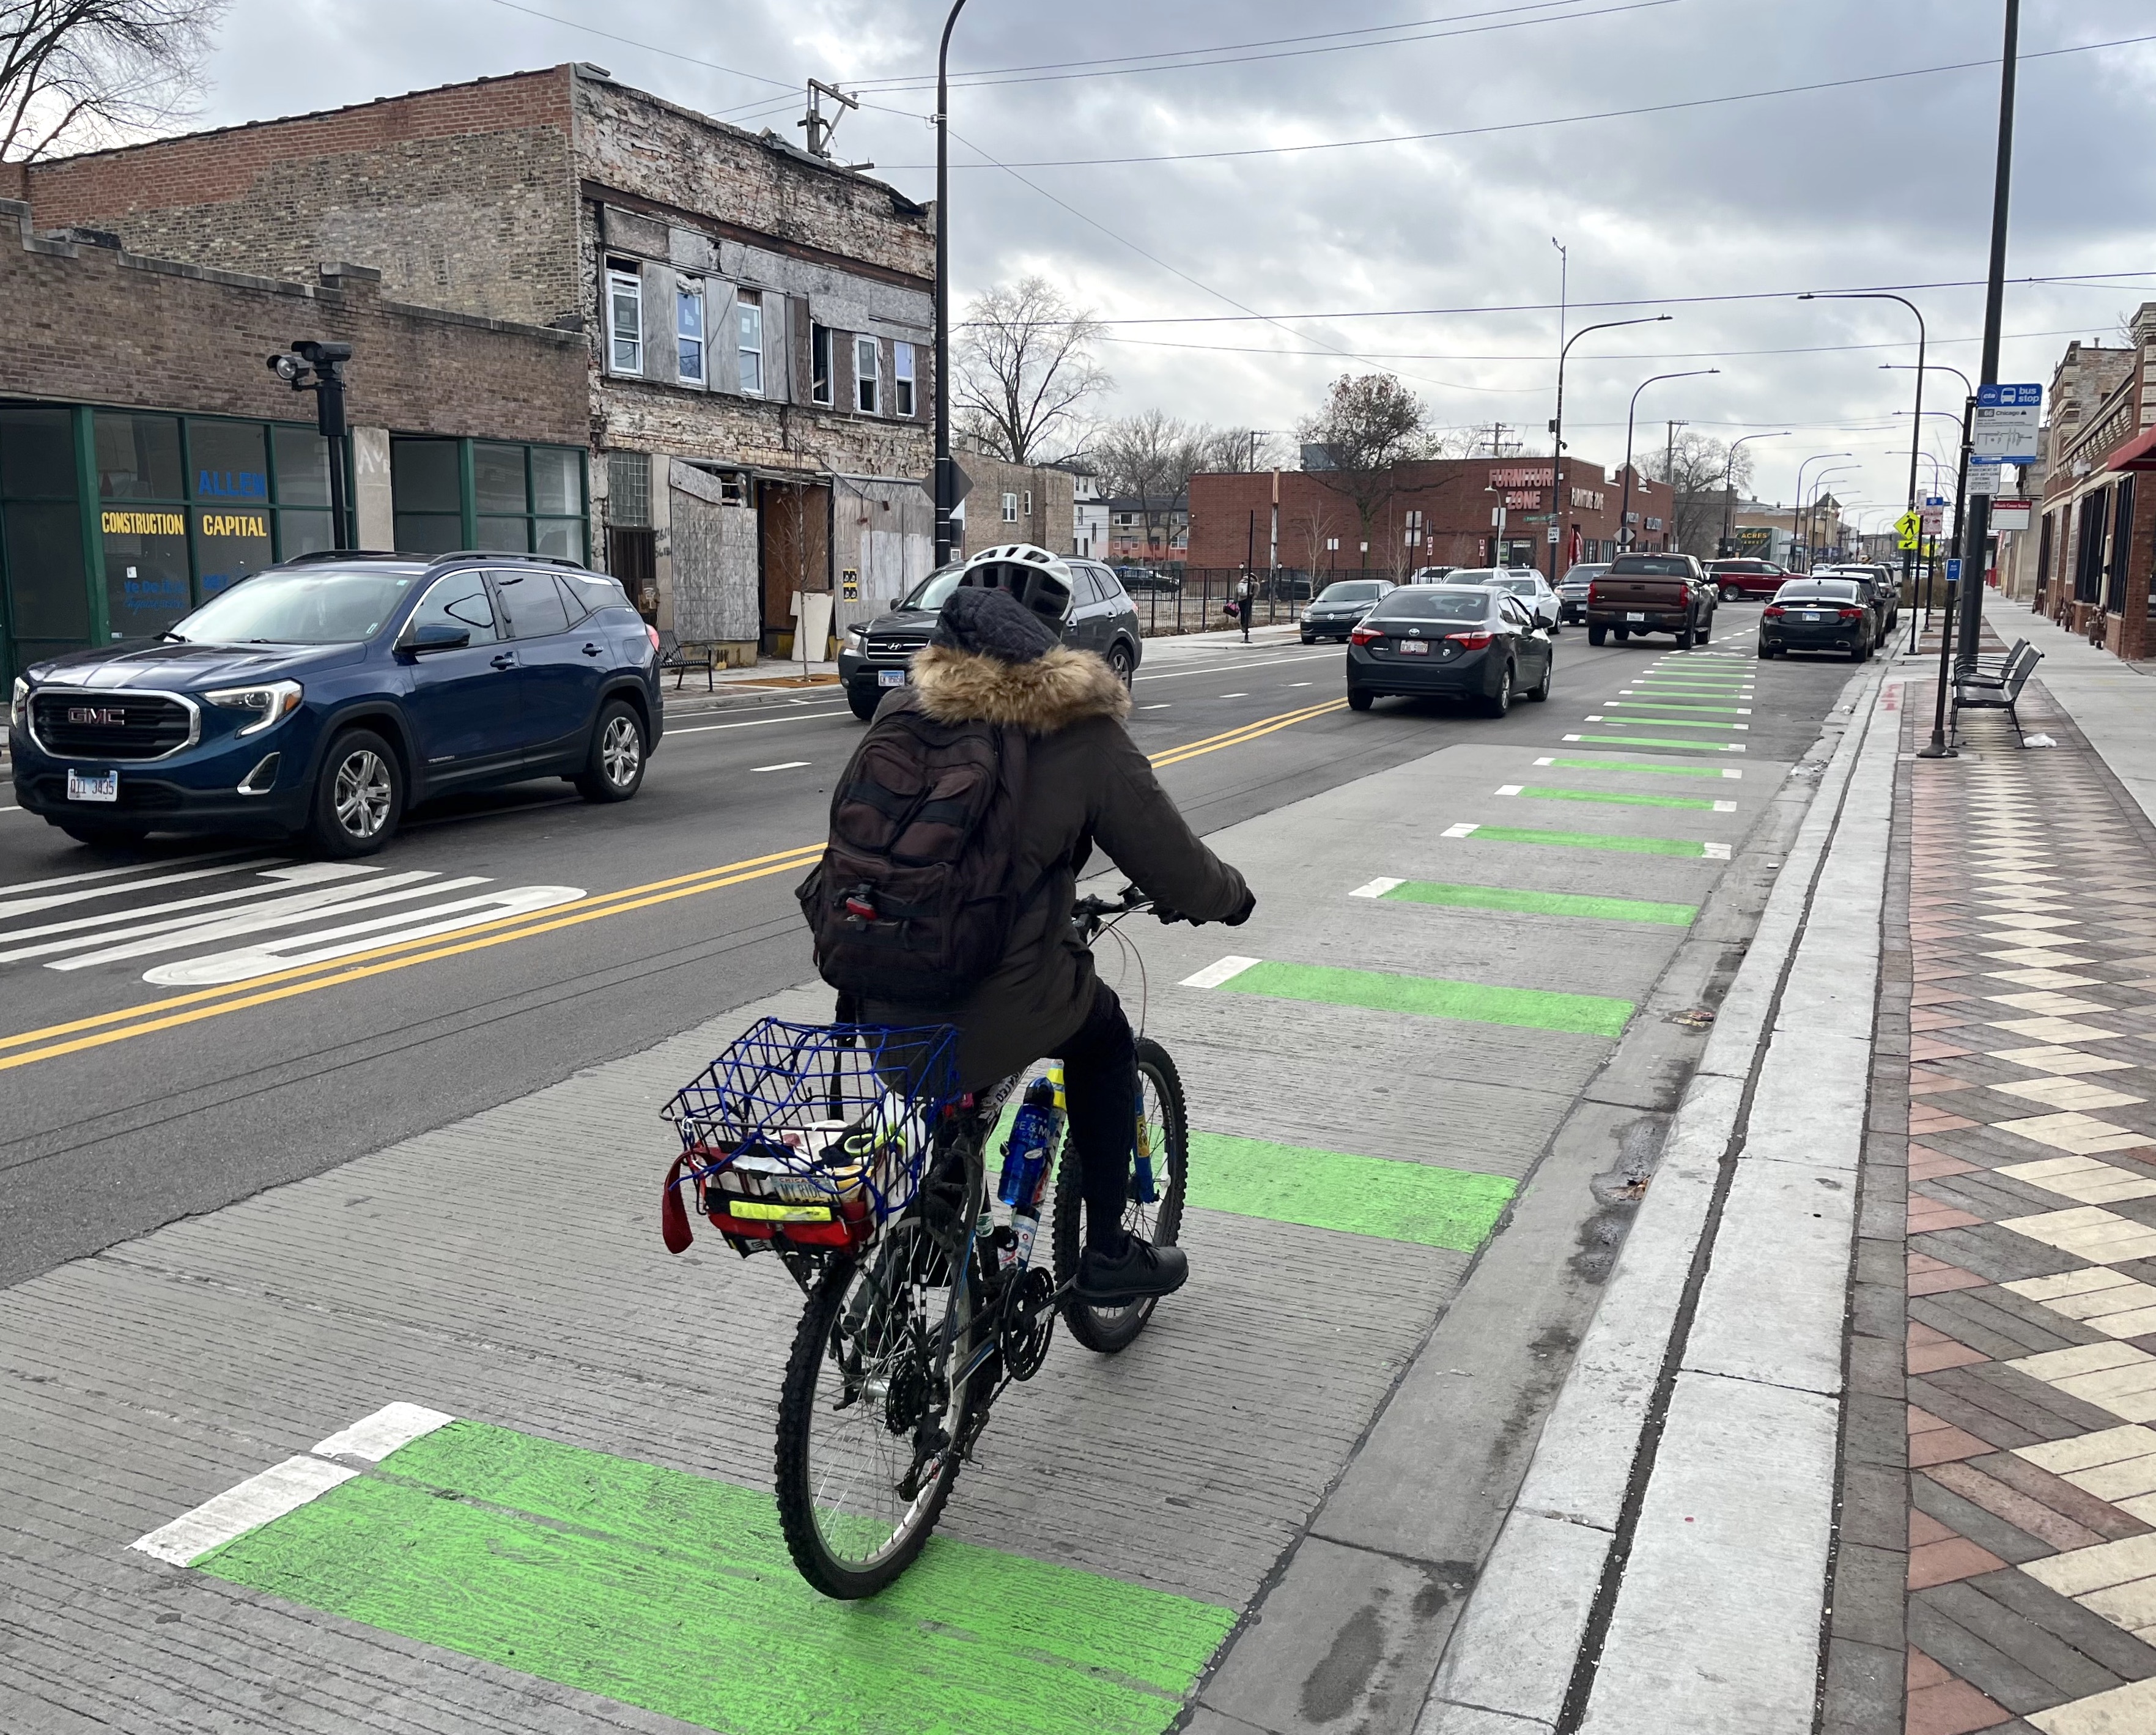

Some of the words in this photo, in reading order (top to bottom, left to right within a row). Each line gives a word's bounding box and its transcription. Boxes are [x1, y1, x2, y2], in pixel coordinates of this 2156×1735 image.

[2018, 395, 2039, 404] stop
[199, 470, 265, 497] ALLEN
[1507, 490, 1541, 509] ZONE
[102, 512, 184, 535] CONSTRUCTION
[203, 514, 267, 536] CAPITAL
[68, 708, 124, 725] GMC
[780, 1183, 796, 1197] MY
